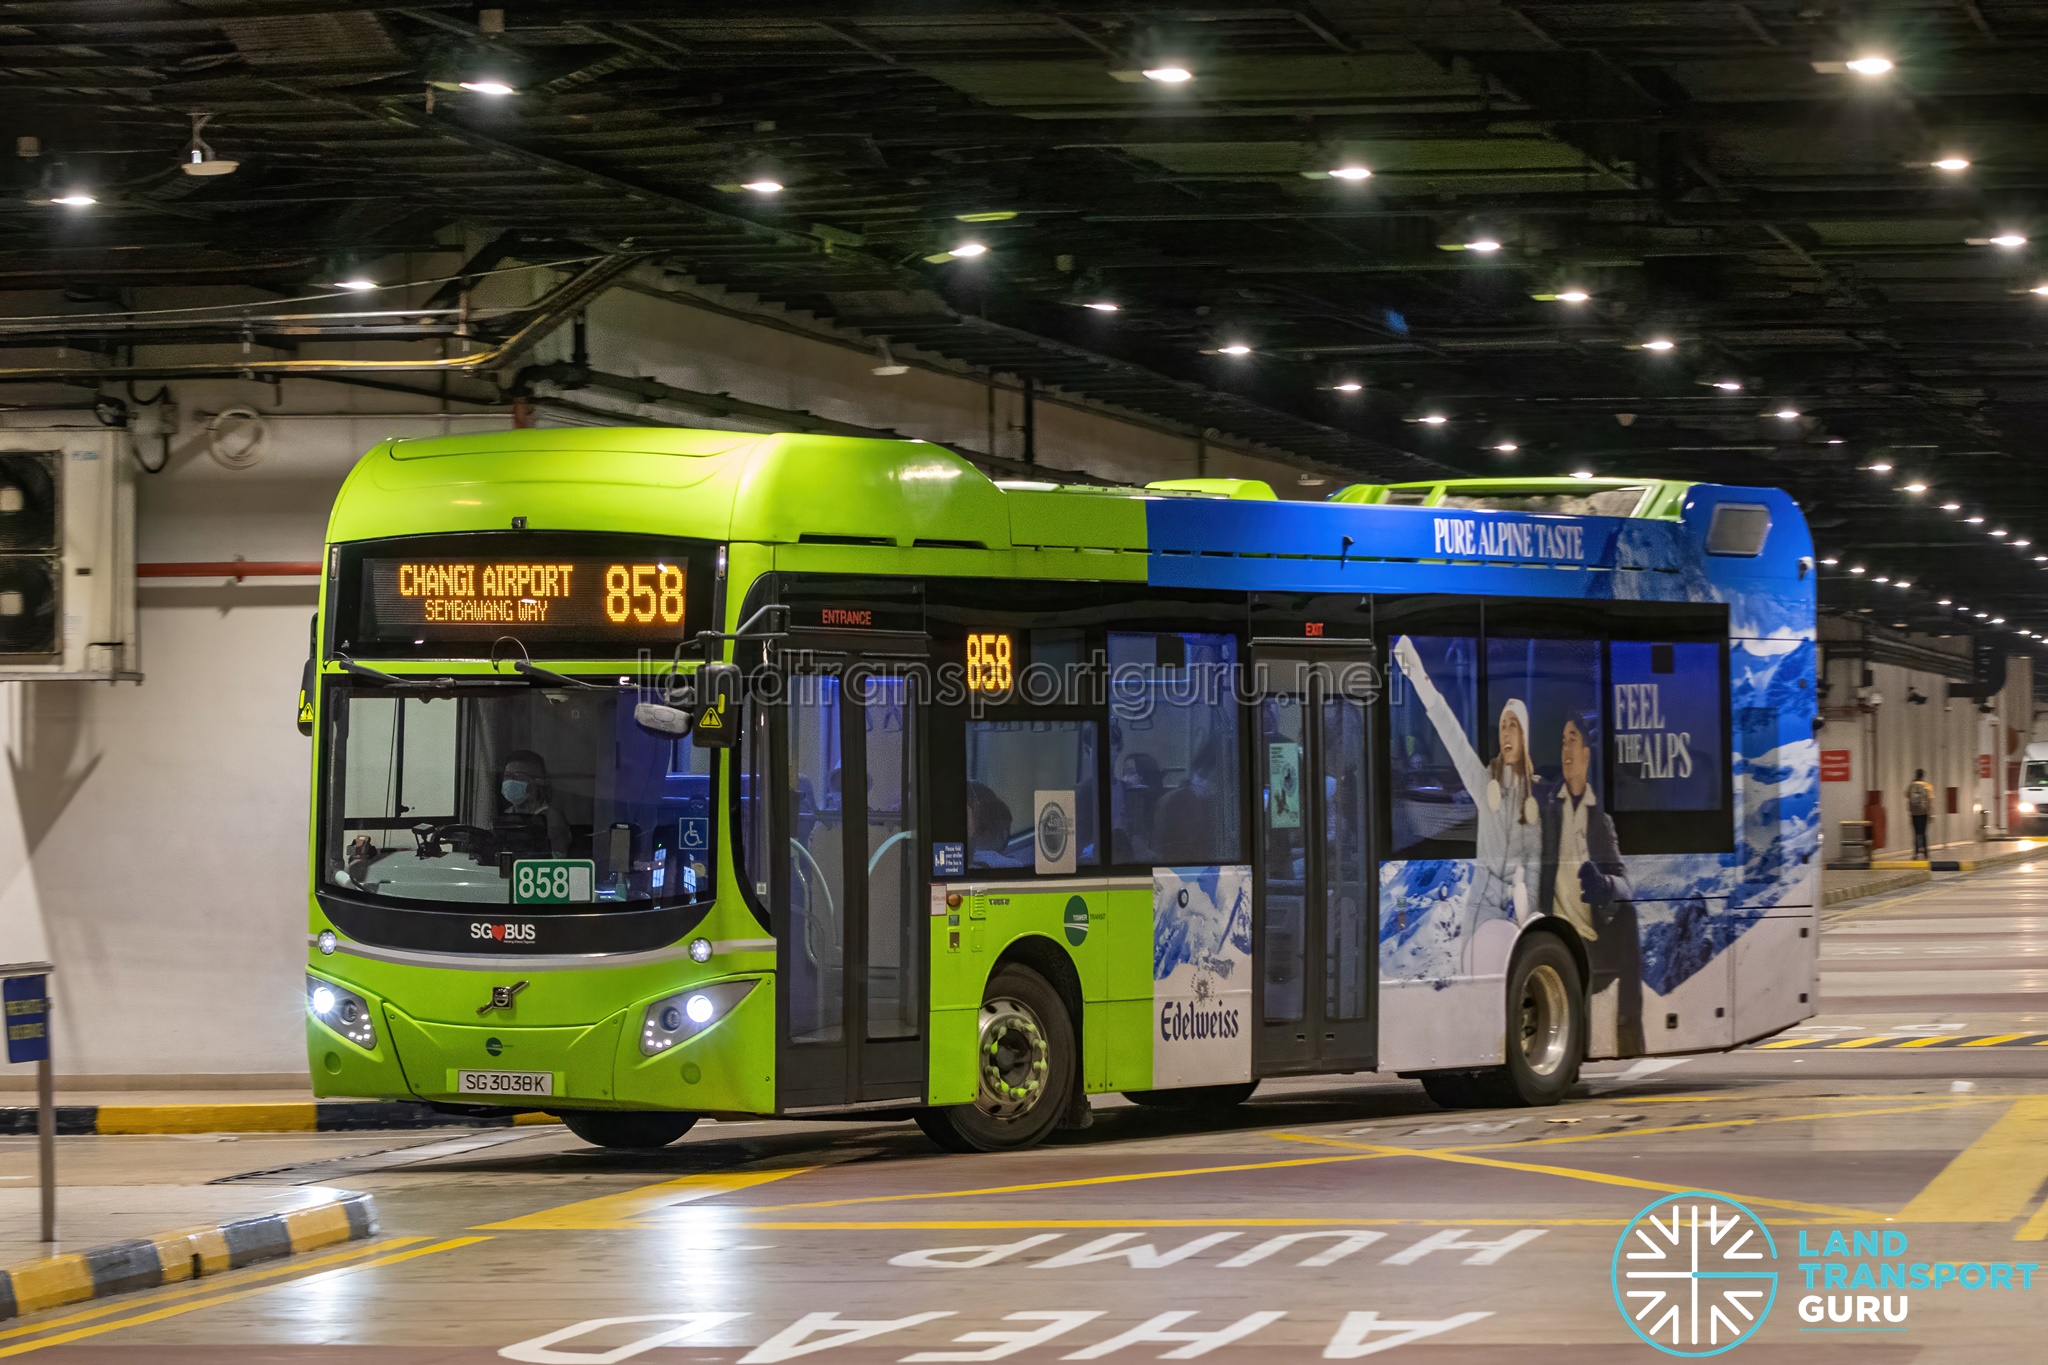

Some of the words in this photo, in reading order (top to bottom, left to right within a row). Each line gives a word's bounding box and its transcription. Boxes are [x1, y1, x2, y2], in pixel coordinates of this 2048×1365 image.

[1433, 517, 1476, 556] PURE
[1478, 521, 1534, 558] ALPINE
[1534, 523, 1585, 560] TASTE
[400, 565, 475, 597] CHANGI
[482, 565, 573, 597] AIRPORT
[606, 565, 684, 623] 858
[425, 600, 513, 621] SEMBAWANG
[517, 599, 548, 621] WAY
[821, 608, 872, 626] ENTRANCE
[1305, 622, 1324, 637] EXIT
[966, 634, 1012, 690] 858
[1614, 683, 1666, 730] FEEL
[1614, 733, 1642, 764] THE
[1640, 731, 1693, 779] ALPS
[518, 866, 569, 899] 858
[470, 922, 493, 939] SG
[504, 923, 536, 940] BUS
[1160, 999, 1239, 1042] Edelweiss
[887, 1228, 1550, 1270] HUMP
[497, 1310, 1498, 1365] AHEAD
